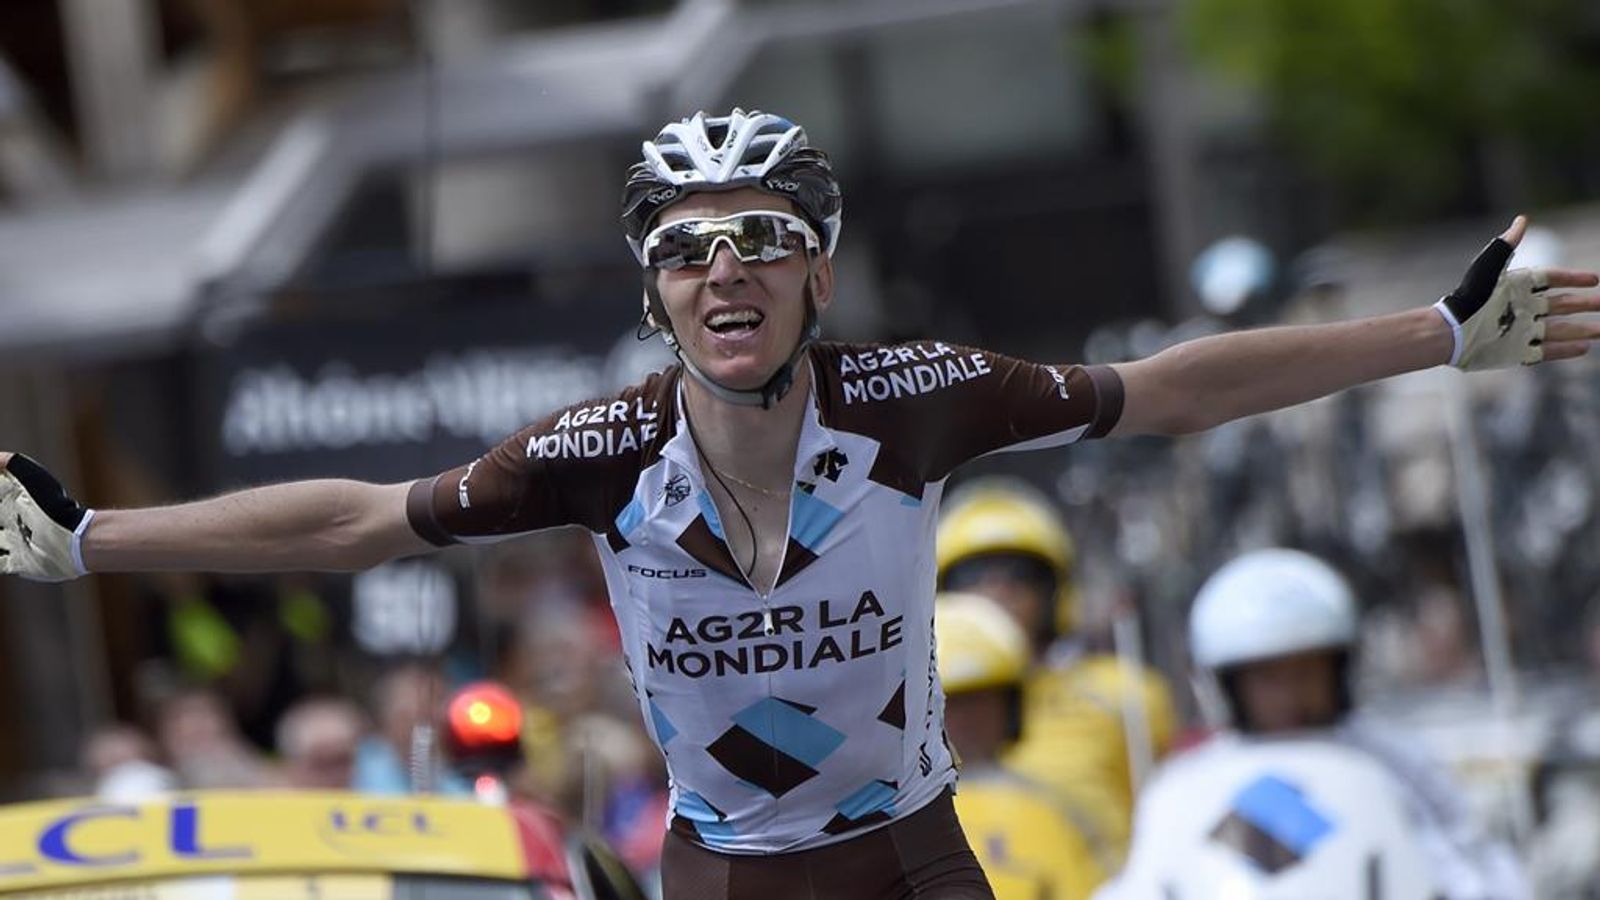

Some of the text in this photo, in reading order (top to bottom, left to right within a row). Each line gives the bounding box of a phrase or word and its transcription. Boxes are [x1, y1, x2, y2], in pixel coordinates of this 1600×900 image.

[840, 346, 920, 377] AG2R
[842, 353, 992, 404] MONDIALE
[554, 397, 657, 431] AG2R L
[628, 565, 707, 579] FOCUS
[666, 590, 885, 645] AG2R LA
[646, 615, 904, 679] MONDIALE
[0, 801, 254, 877] CL
